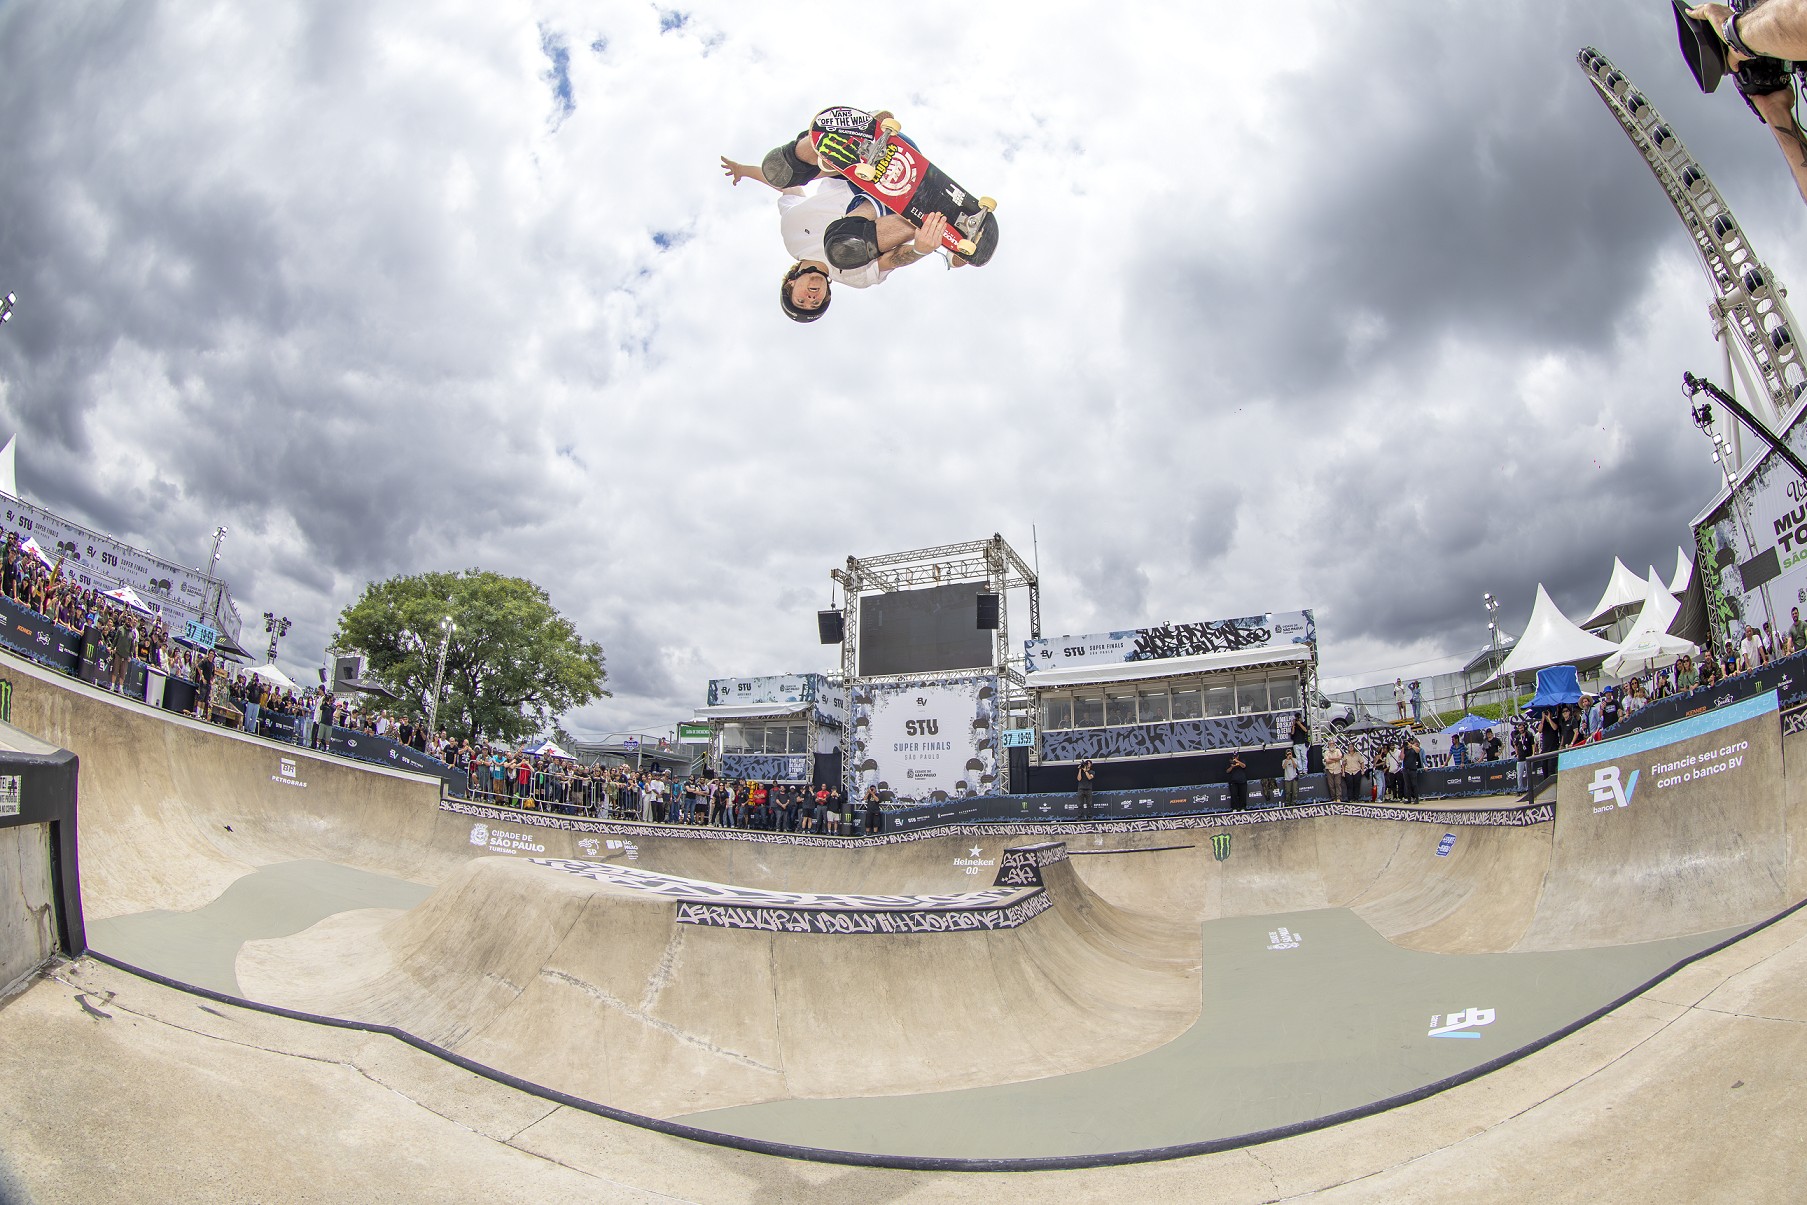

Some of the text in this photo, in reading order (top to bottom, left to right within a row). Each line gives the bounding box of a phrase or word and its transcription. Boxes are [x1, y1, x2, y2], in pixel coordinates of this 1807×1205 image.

[834, 118, 850, 126] THE
[18, 515, 33, 531] STU
[1773, 503, 1807, 536] MU
[101, 552, 118, 567] STU
[80, 574, 92, 586] STU
[148, 602, 160, 613] STU
[1064, 646, 1086, 657] STU
[738, 683, 752, 691] STU
[906, 719, 938, 736] STU
[1004, 732, 1031, 746] 37 19:59
[893, 742, 951, 752] SUPER FINALS
[1425, 754, 1448, 768] STU
[1652, 740, 1748, 775] Financie seu carro
[1657, 755, 1743, 789] com o banco BV
[272, 775, 307, 788] PETROBRAS
[1593, 803, 1614, 814] banco
[492, 829, 520, 840] CIDADE
[489, 846, 516, 854] TURISMO
[490, 836, 545, 852] SÃO PAULO
[953, 858, 994, 866] Heineken
